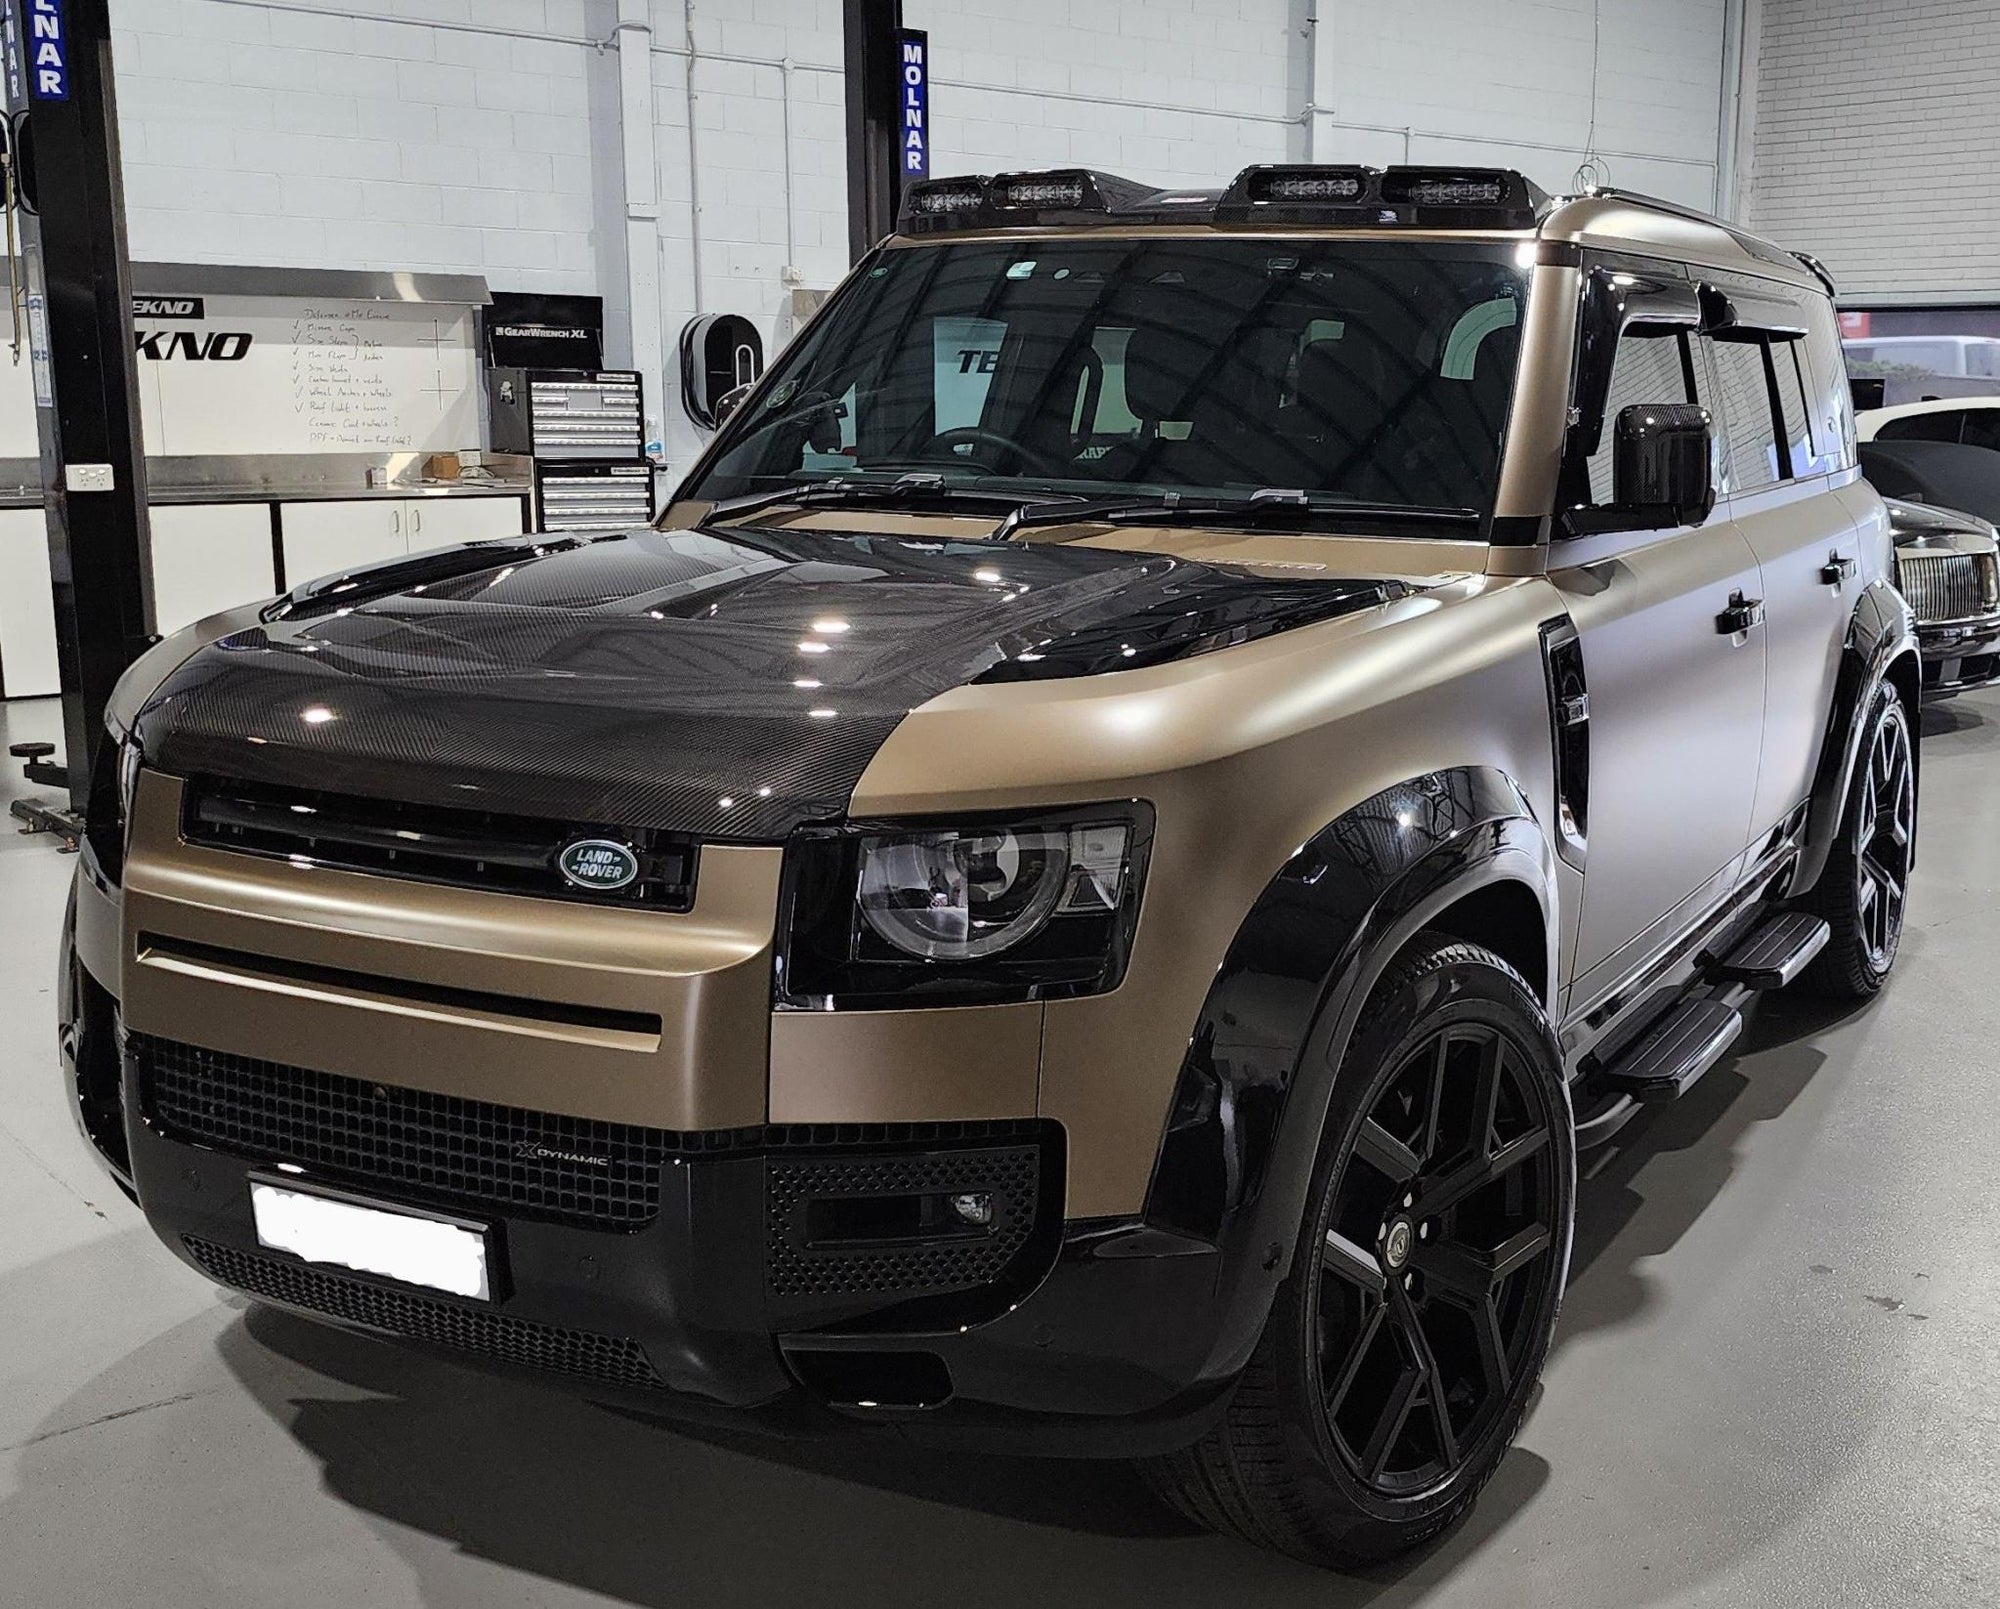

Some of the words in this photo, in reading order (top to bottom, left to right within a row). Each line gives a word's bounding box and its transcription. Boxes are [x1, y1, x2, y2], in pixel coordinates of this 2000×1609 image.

[903, 44, 923, 170] MOLNAR
[570, 329, 588, 339] XL
[576, 848, 614, 864] LAND
[578, 862, 622, 879] ROVER
[537, 1148, 608, 1167] DYNAMIC
